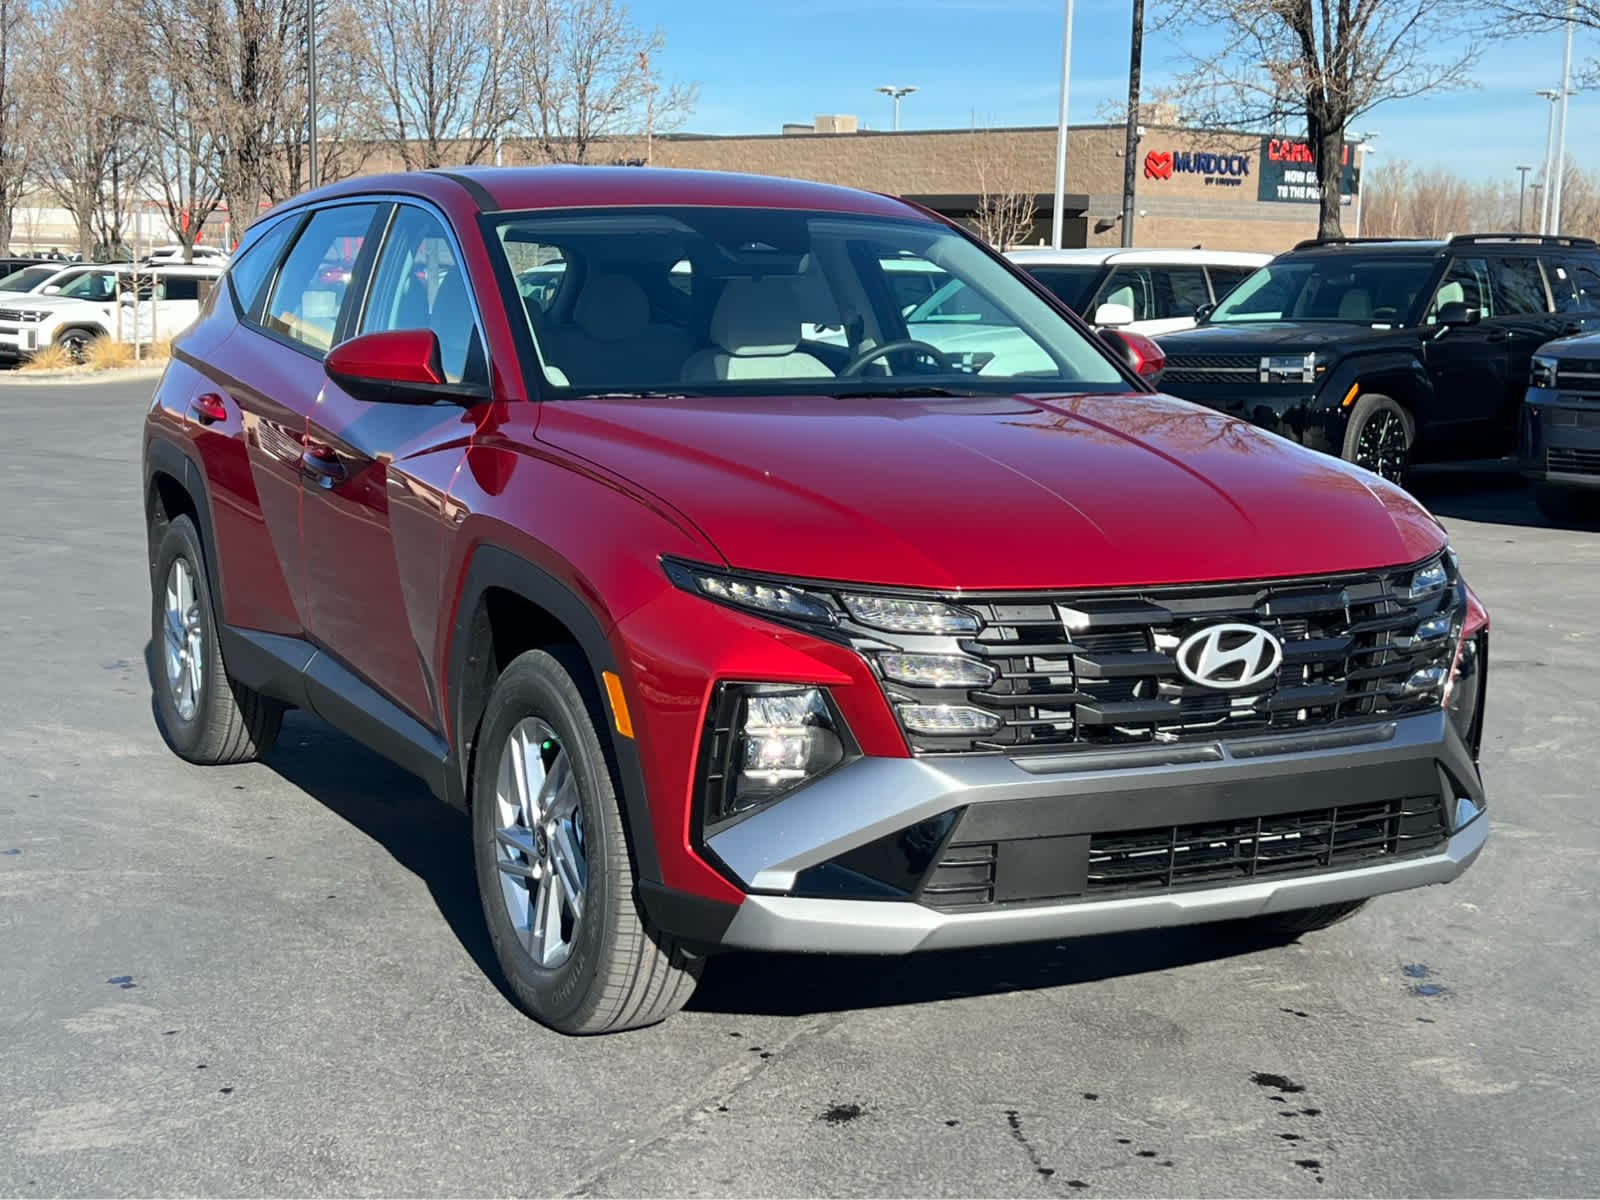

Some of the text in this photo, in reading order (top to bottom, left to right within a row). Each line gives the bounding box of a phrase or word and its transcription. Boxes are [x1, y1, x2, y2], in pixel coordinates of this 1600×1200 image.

[1172, 151, 1250, 177] MURDOCK
[1284, 170, 1306, 184] NOW
[1277, 185, 1288, 199] TO
[1289, 186, 1306, 200] THE
